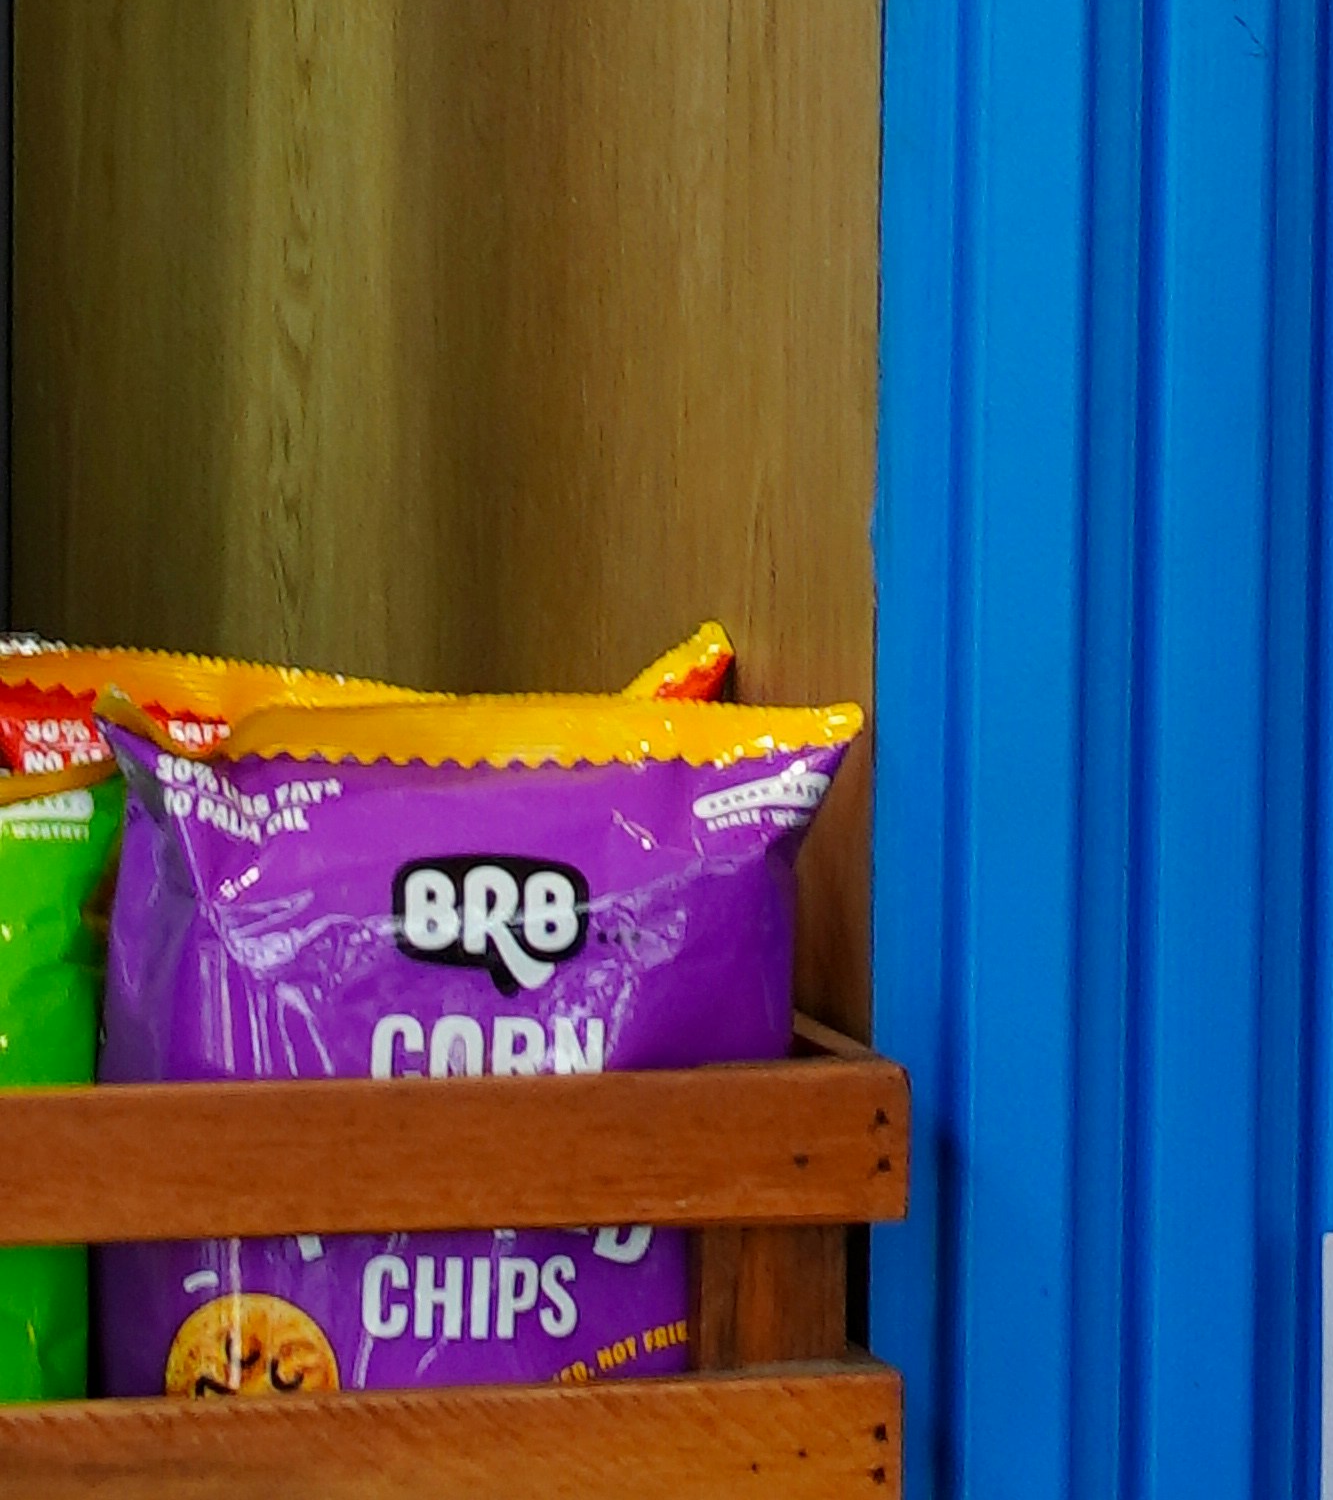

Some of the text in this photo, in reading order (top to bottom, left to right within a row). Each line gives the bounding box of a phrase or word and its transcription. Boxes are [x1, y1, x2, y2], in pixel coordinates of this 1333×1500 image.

[24, 719, 91, 744] 30%
[23, 749, 63, 774] NO
[156, 753, 219, 793] 30%
[197, 796, 261, 844] PALM
[266, 806, 309, 835] OIL
[403, 864, 585, 991] BRB
[370, 1015, 605, 1080] CORN
[362, 1254, 579, 1340] CHIPS
[596, 1336, 637, 1372] NOT
